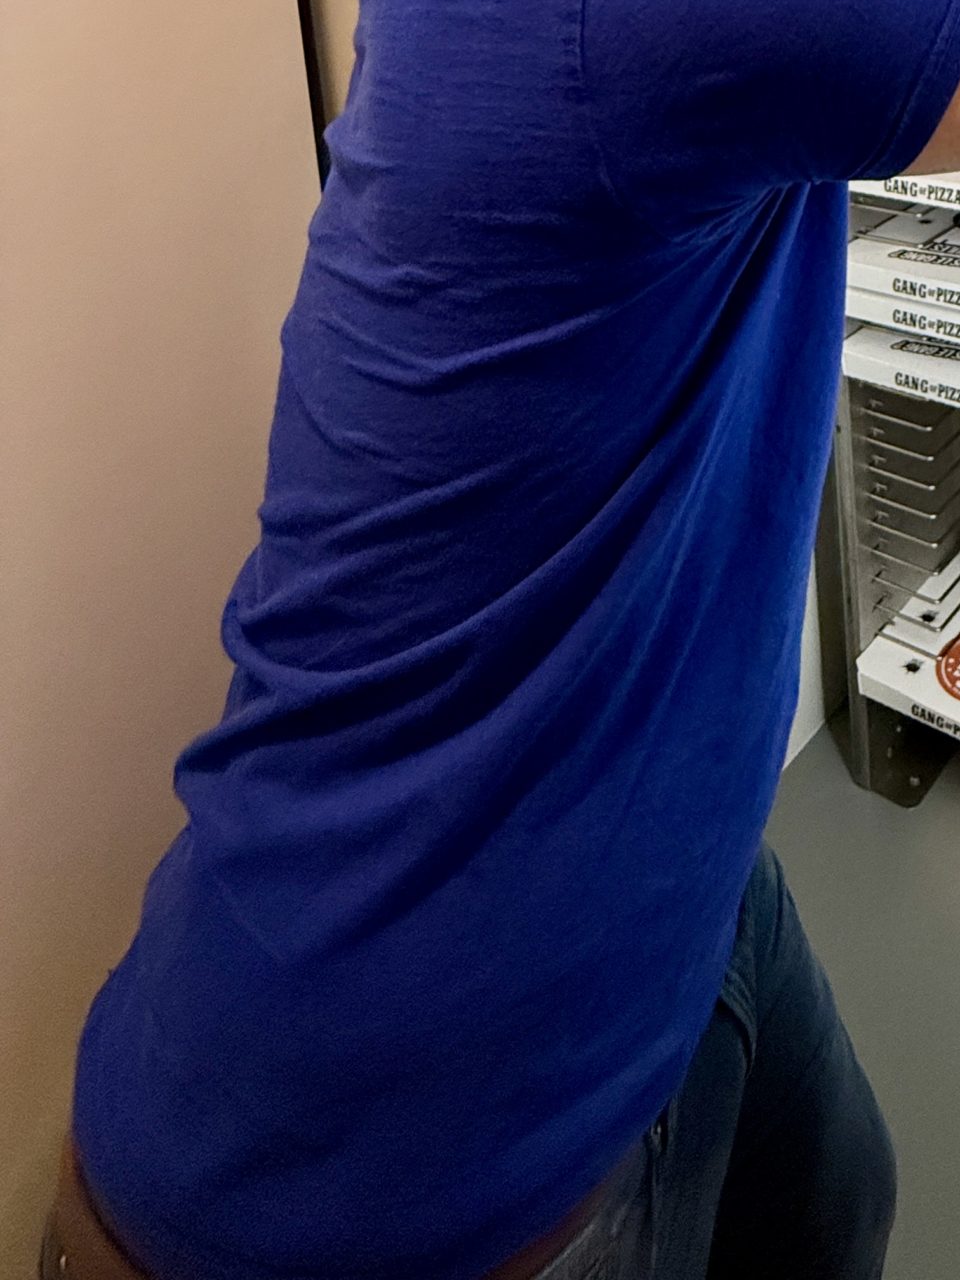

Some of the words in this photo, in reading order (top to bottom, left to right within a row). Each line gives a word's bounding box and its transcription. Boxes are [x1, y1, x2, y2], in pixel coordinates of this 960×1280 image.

[884, 179, 918, 197] GANG
[892, 278, 926, 298] GANG
[892, 309, 926, 329] GANG
[895, 372, 928, 393] GANG
[912, 704, 945, 728] GANG
